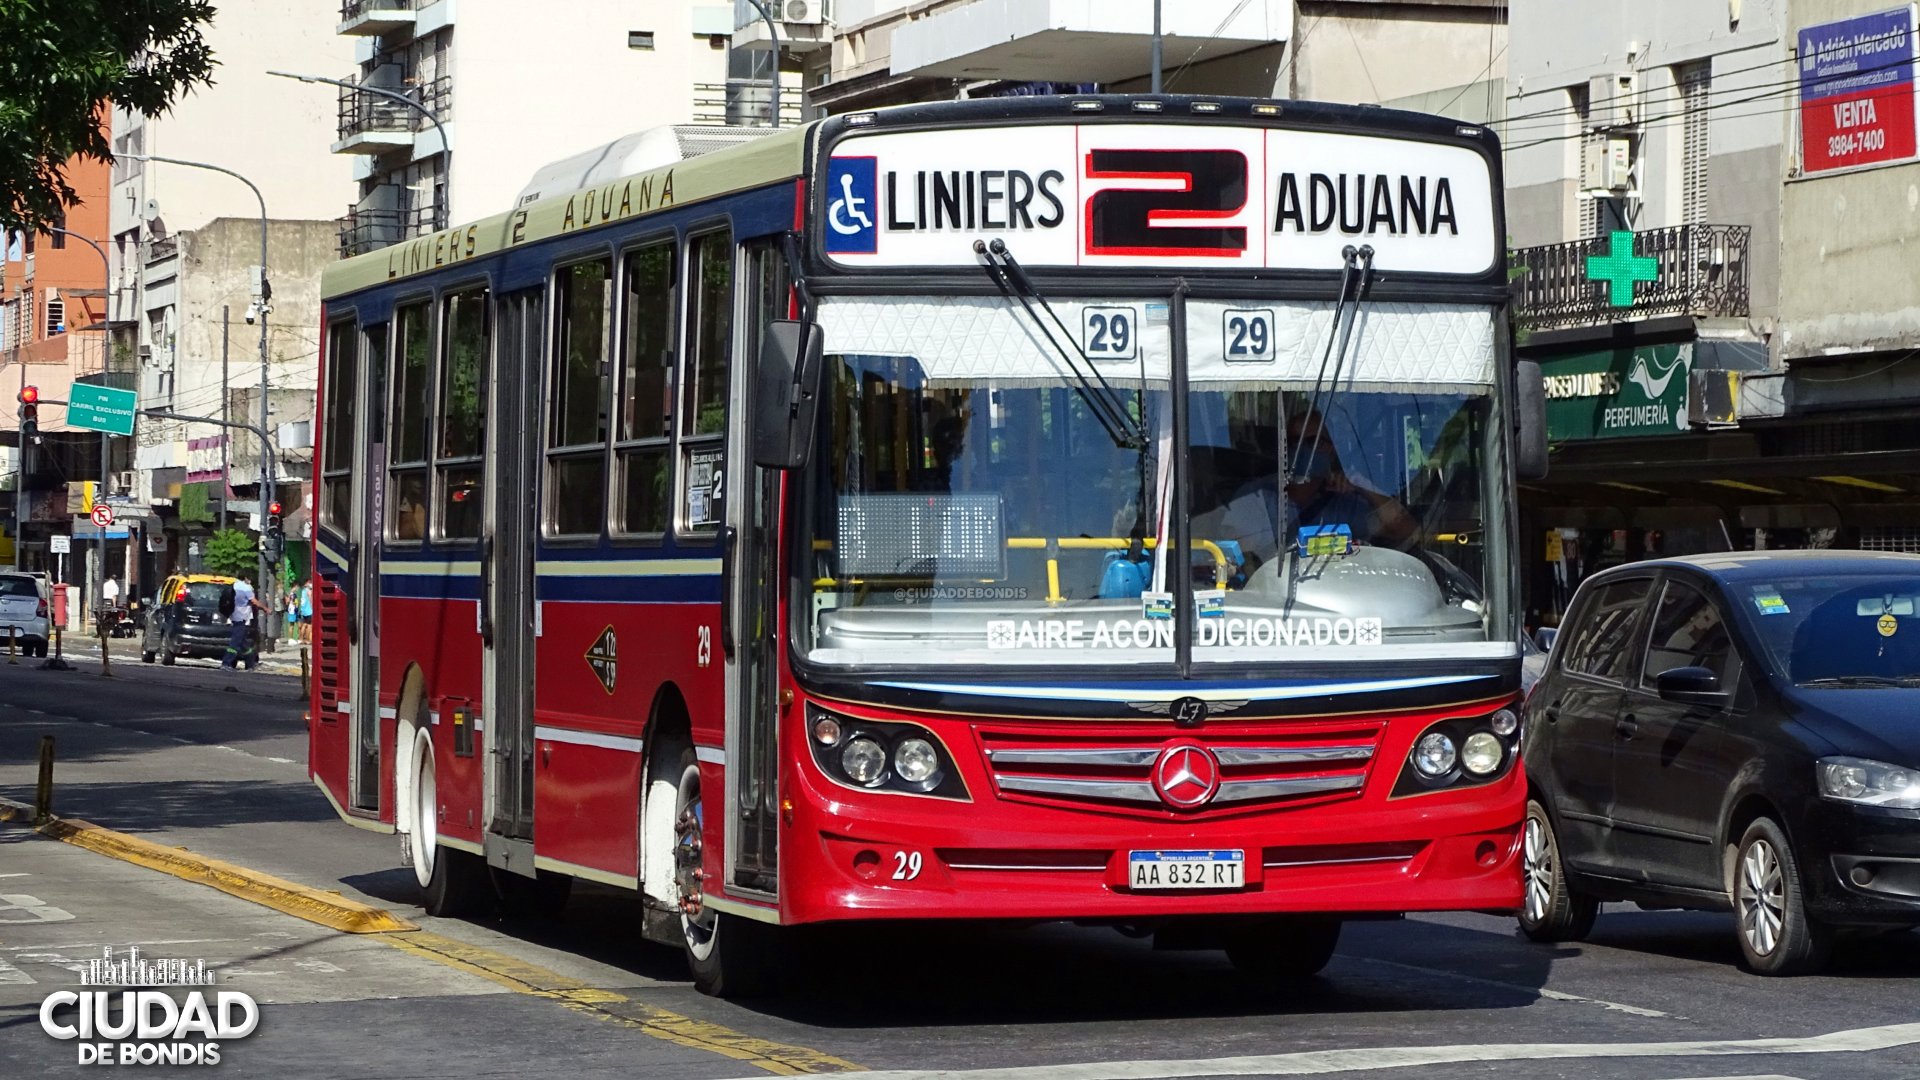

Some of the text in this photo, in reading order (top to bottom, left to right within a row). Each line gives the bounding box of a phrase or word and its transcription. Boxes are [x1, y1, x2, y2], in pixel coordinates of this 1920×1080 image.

[1817, 25, 1905, 63] Adrián Mercado
[1833, 98, 1877, 129] VENTA
[1828, 128, 1885, 158] 3984-7400
[886, 148, 1459, 256] LINIERS 2 ADUANA
[388, 168, 674, 280] LINIERS 2 ADUANA
[1089, 313, 1130, 353] 29
[1229, 316, 1268, 355] 29
[71, 402, 132, 416] CARRIL EXCLUSIVO
[92, 415, 107, 423] BUS
[1604, 399, 1669, 429] PERFUMERÍA
[713, 470, 723, 499] 2
[839, 507, 866, 559] R
[698, 625, 710, 667] 29
[1016, 617, 1355, 649] AIRE ACON DICIONADO
[892, 850, 922, 880] 29
[1136, 863, 1237, 885] AA 832 RT
